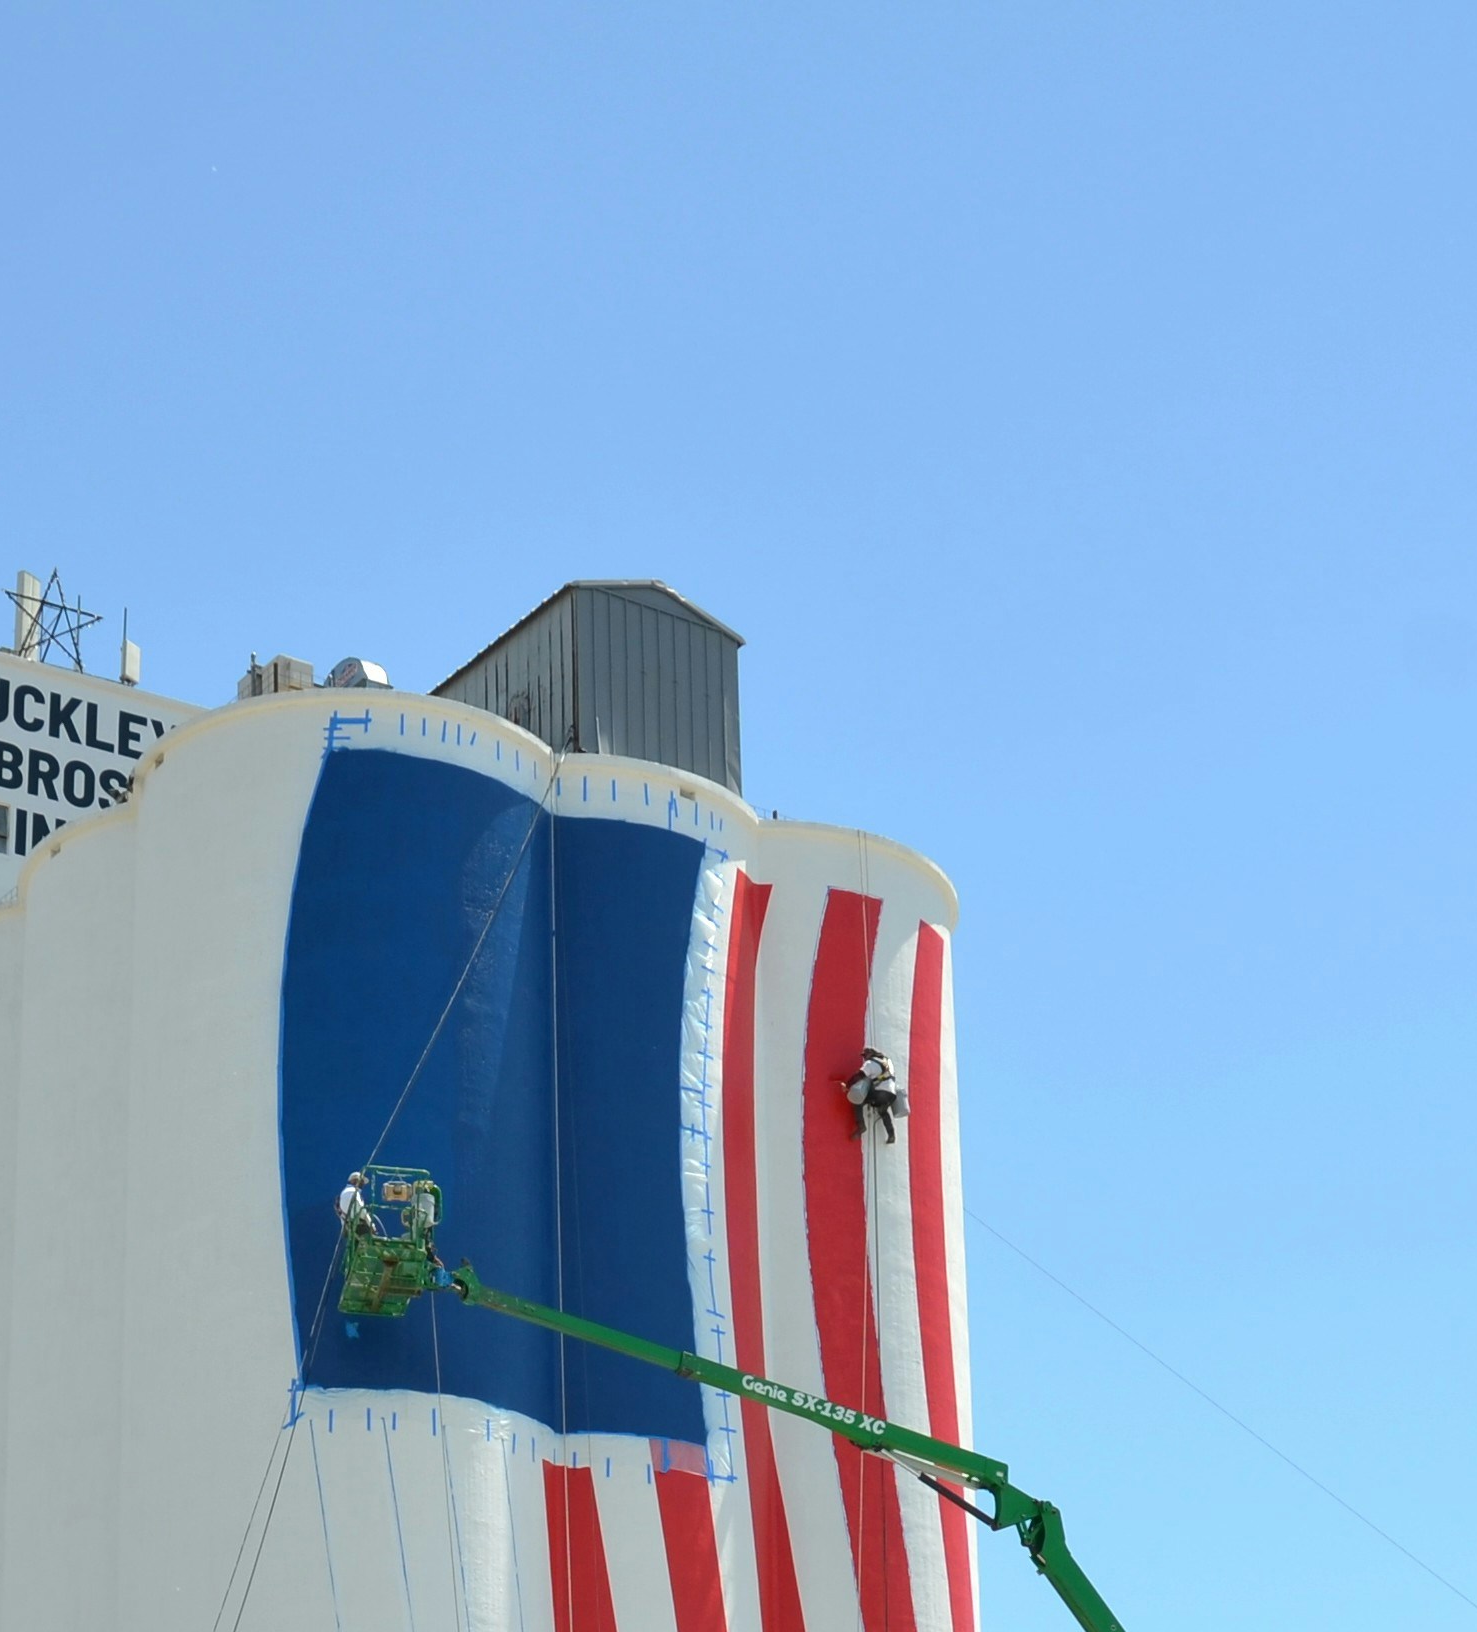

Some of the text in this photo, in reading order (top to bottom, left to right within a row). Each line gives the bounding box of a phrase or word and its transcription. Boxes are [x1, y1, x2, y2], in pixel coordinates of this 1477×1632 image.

[742, 1375, 886, 1435] Genie SX-135 XC
